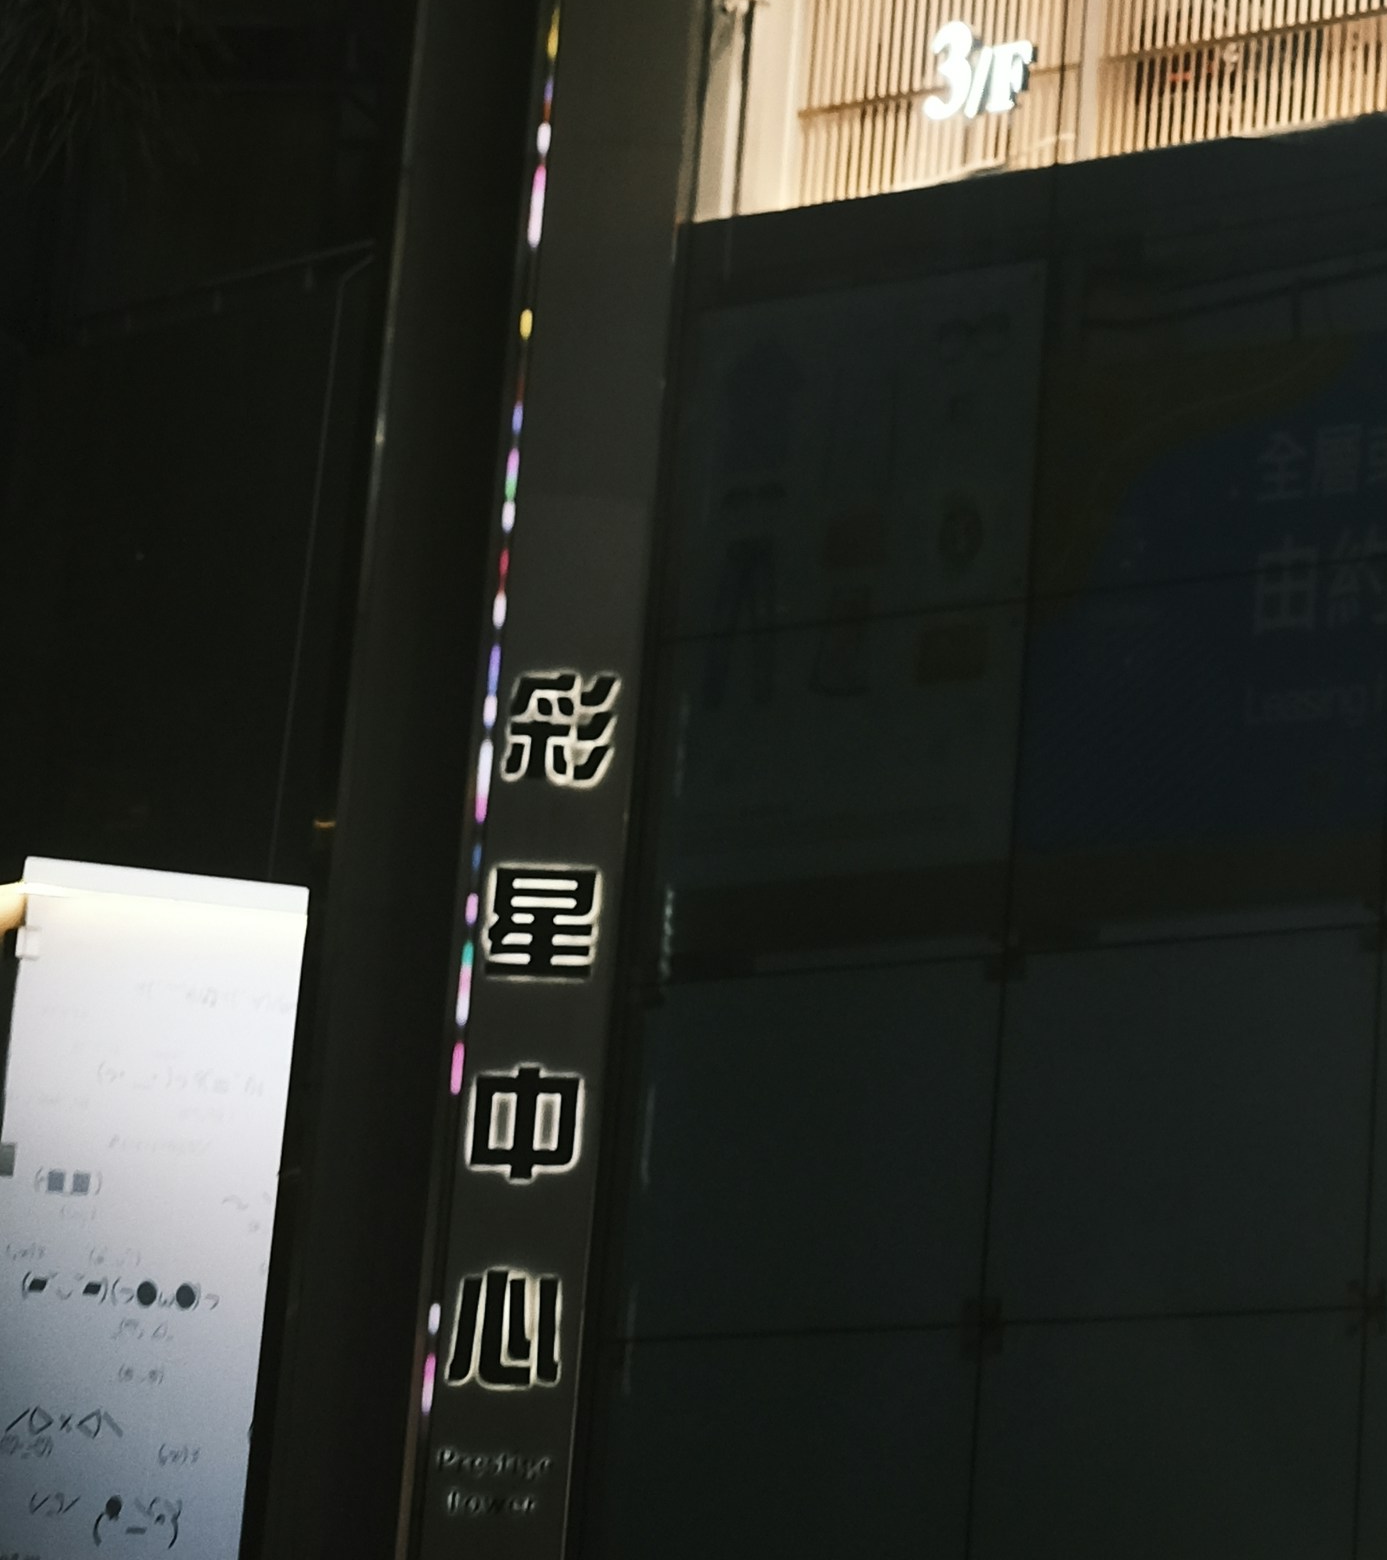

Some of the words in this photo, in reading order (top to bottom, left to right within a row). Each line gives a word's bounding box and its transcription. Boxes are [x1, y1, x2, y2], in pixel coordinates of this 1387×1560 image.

[922, 18, 1037, 121] 3/F
[443, 669, 622, 1391] 彩星中心
